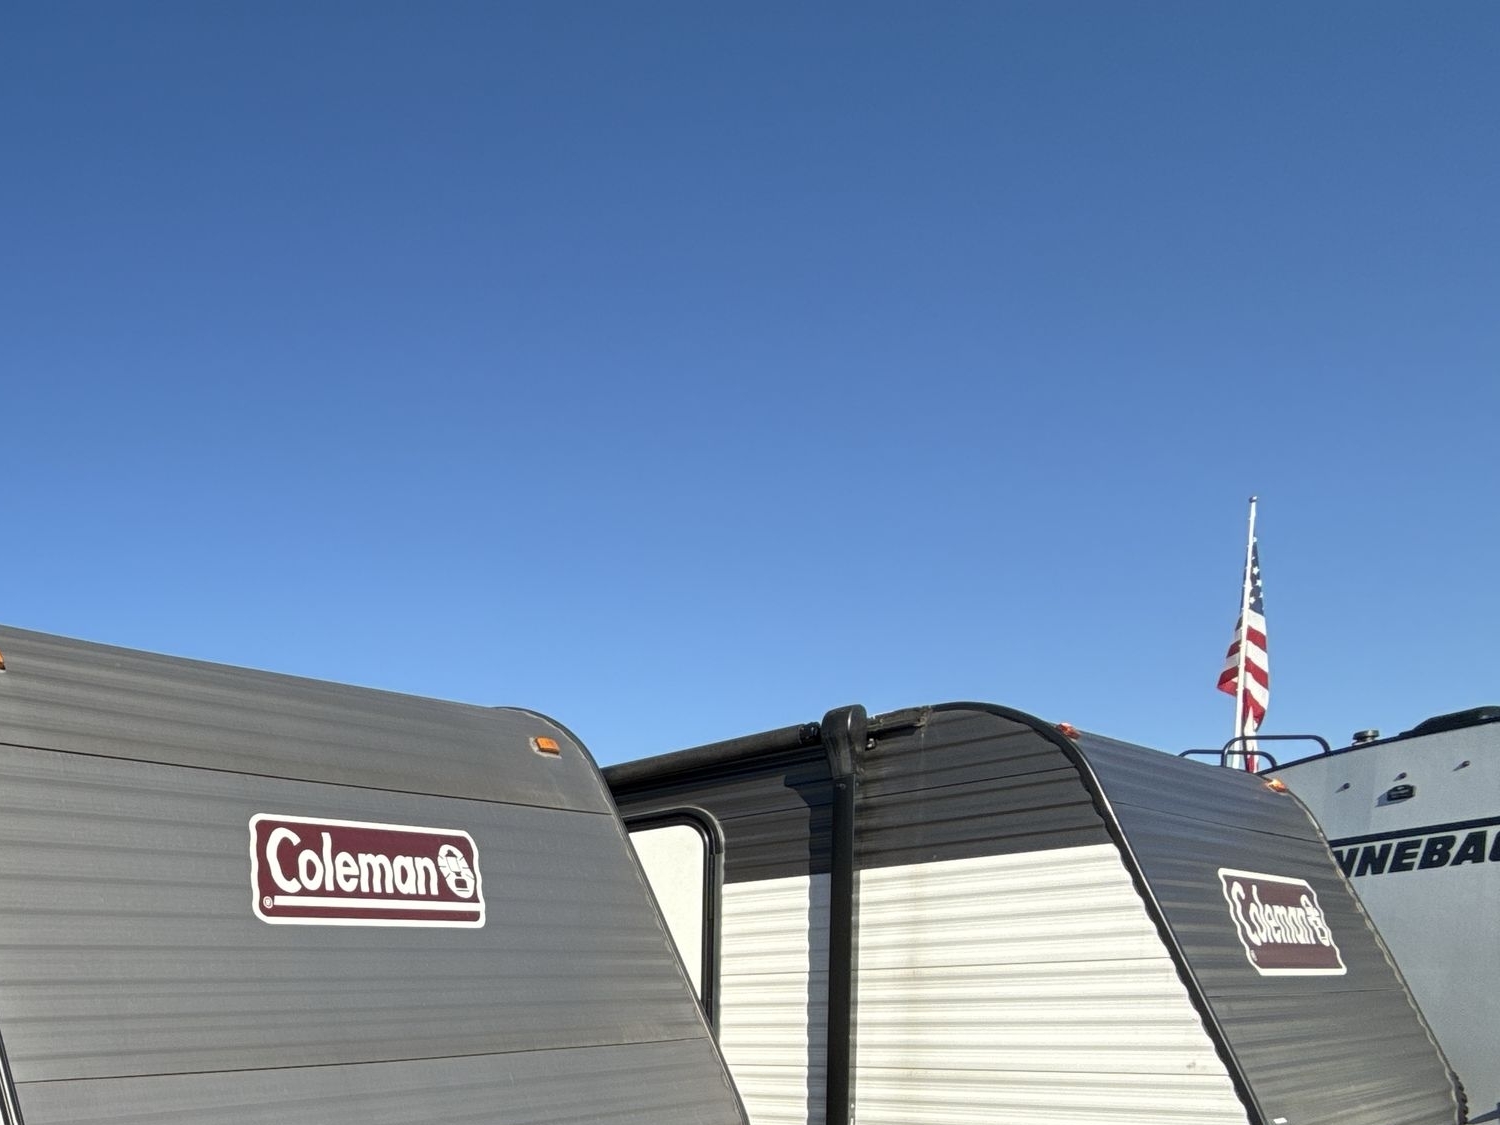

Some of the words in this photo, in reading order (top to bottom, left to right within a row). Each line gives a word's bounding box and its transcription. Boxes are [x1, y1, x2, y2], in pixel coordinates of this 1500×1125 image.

[266, 827, 439, 896] Coleman
[1332, 830, 1500, 878] NNEBA
[1231, 881, 1316, 946] Coleman
